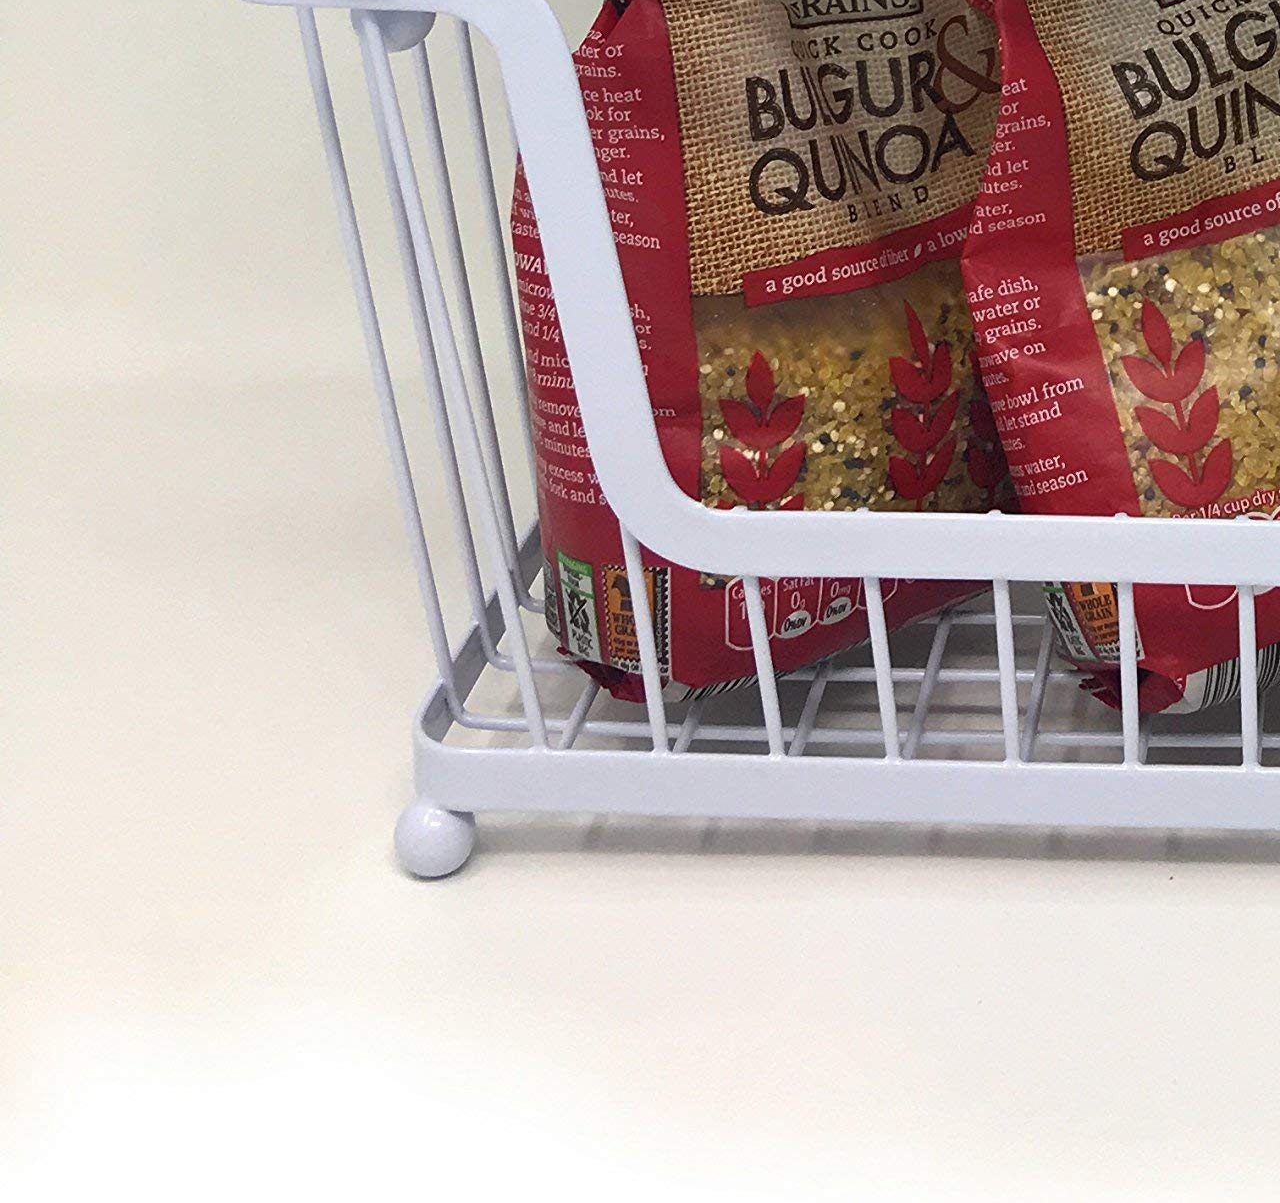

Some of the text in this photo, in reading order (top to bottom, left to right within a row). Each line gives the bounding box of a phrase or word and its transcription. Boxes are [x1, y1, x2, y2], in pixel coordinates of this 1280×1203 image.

[857, 19, 937, 51] COOK
[605, 44, 624, 58] or
[603, 87, 642, 102] heat
[608, 106, 631, 121] for
[608, 125, 665, 144] grains,
[996, 113, 1051, 139] grains,
[1007, 159, 1029, 174] let
[622, 169, 644, 185] let
[988, 211, 1047, 232] season
[1143, 231, 1155, 246] a
[1159, 219, 1201, 248] good
[1204, 203, 1263, 231] source
[613, 230, 661, 249] season
[765, 278, 777, 294] a
[782, 268, 828, 295] good
[832, 259, 879, 284] source
[928, 239, 937, 253] a
[938, 226, 968, 251] low
[998, 277, 1040, 297] dish,
[973, 295, 1041, 323] water or
[635, 324, 651, 335] or
[985, 318, 1042, 344] grains.
[1023, 341, 1047, 355] on
[1007, 388, 1038, 410] bowl
[1042, 376, 1085, 400] from
[1018, 402, 1062, 428] stand
[549, 420, 569, 436] and
[1025, 455, 1066, 475] water,
[1038, 469, 1089, 495] season
[571, 487, 595, 504] and
[1223, 499, 1250, 514] cup
[1252, 490, 1275, 506] dry
